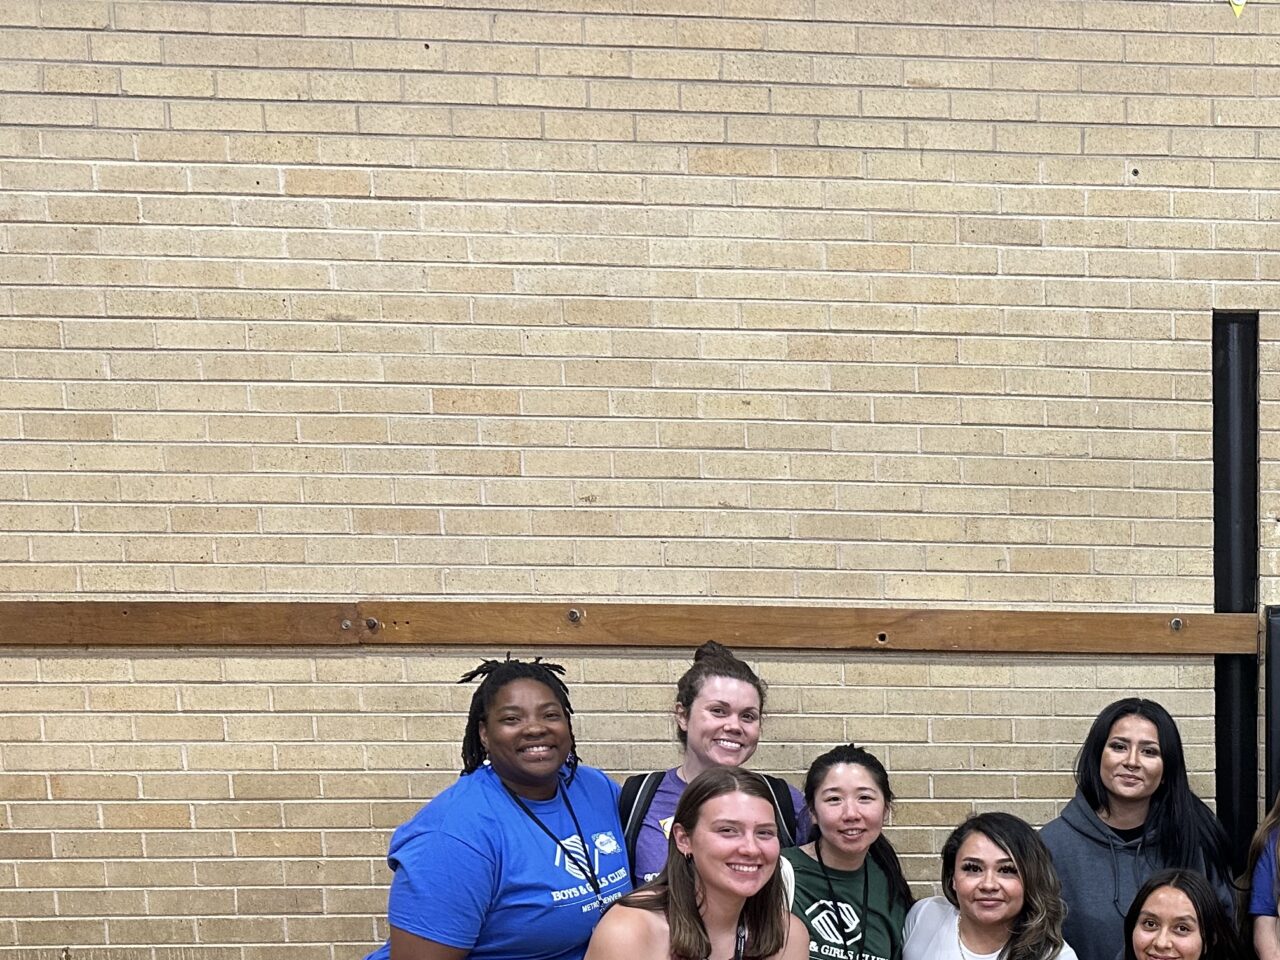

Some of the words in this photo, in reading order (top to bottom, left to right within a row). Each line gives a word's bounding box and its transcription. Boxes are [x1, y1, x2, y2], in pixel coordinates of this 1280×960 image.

[551, 887, 580, 902] BOYS
[580, 884, 589, 895] &
[586, 878, 608, 893] GLS
[607, 867, 628, 884] CLUBS
[808, 941, 819, 953] &
[820, 944, 854, 960] GIRLS
